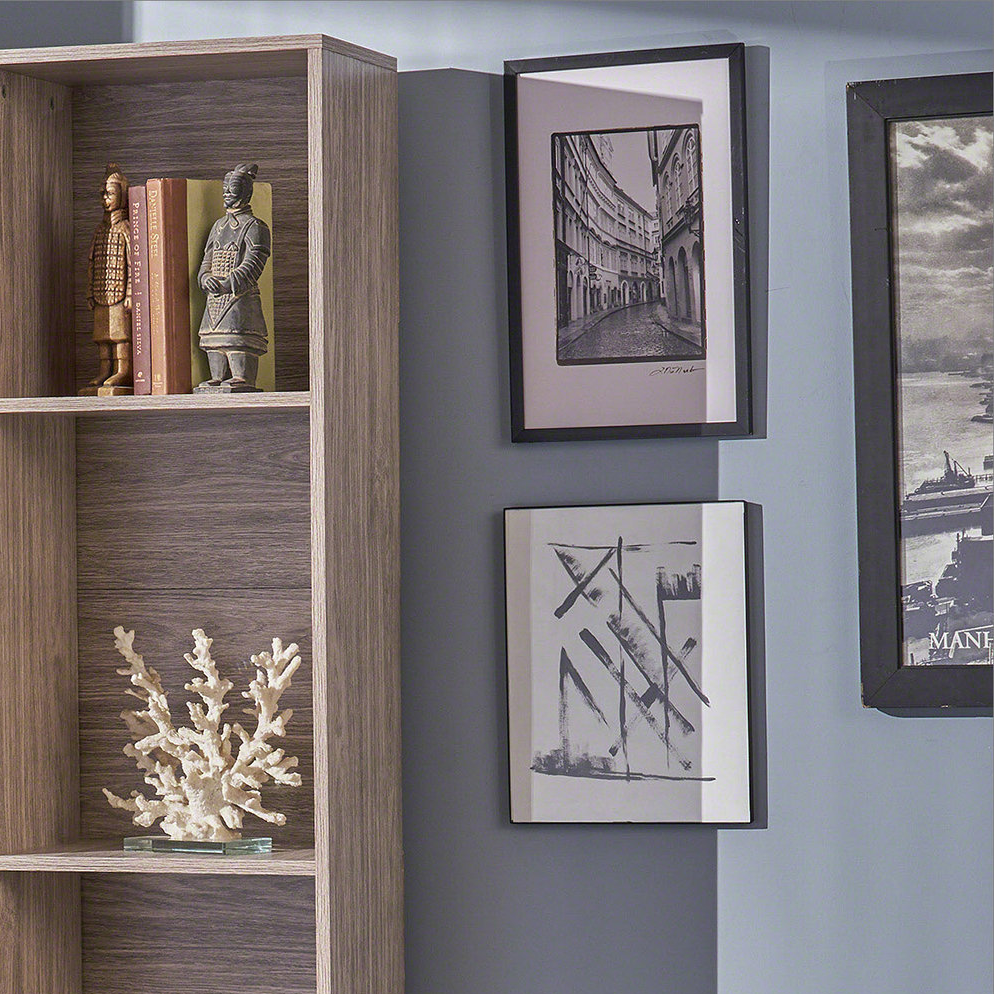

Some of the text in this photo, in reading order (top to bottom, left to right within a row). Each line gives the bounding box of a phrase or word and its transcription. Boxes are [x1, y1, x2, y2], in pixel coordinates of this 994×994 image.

[132, 202, 142, 284] PRINCE OF FIRE
[150, 233, 160, 259] STEEL
